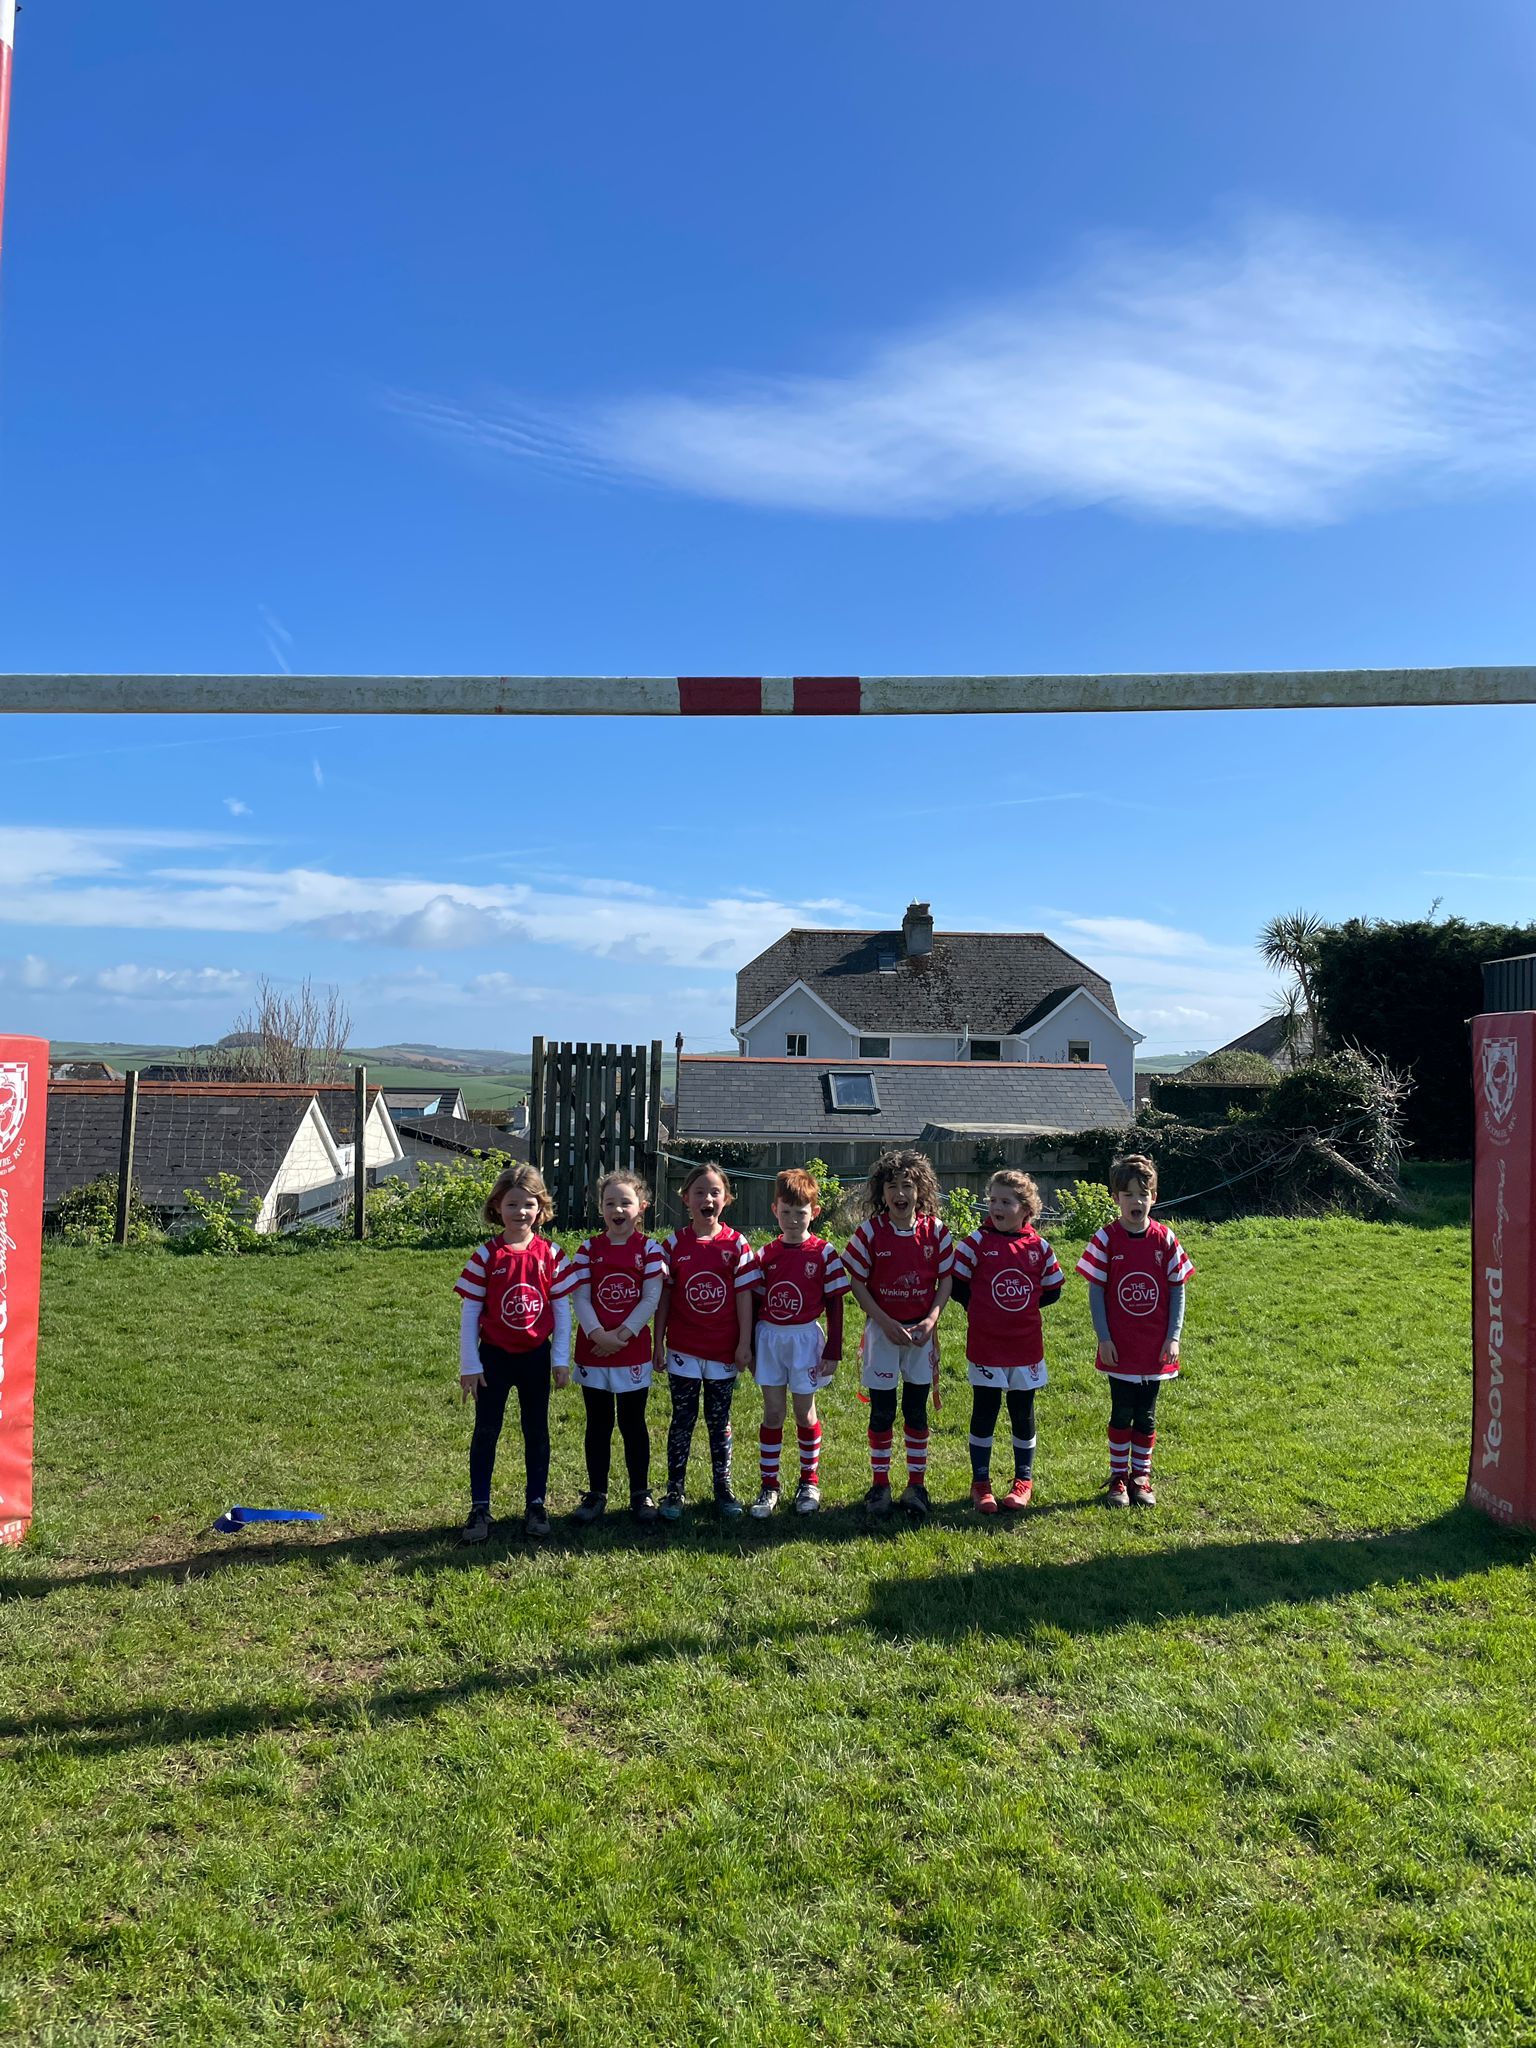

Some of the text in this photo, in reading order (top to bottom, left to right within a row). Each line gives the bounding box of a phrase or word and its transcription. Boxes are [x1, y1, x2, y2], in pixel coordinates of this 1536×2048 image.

[12, 1137, 26, 1160] RFC
[610, 1282, 625, 1290] THE
[697, 1281, 712, 1289] THE
[1004, 1278, 1019, 1286] THE
[1131, 1282, 1145, 1290] THE
[600, 1288, 638, 1300] COVE
[689, 1286, 723, 1301] COVE
[777, 1291, 788, 1299] THE
[879, 1287, 910, 1298] Winking
[994, 1283, 1030, 1297] COVE
[1121, 1287, 1157, 1302] COVE
[513, 1294, 529, 1302] THE
[504, 1300, 540, 1316] COVE
[1482, 1266, 1505, 1469] Yeoward
